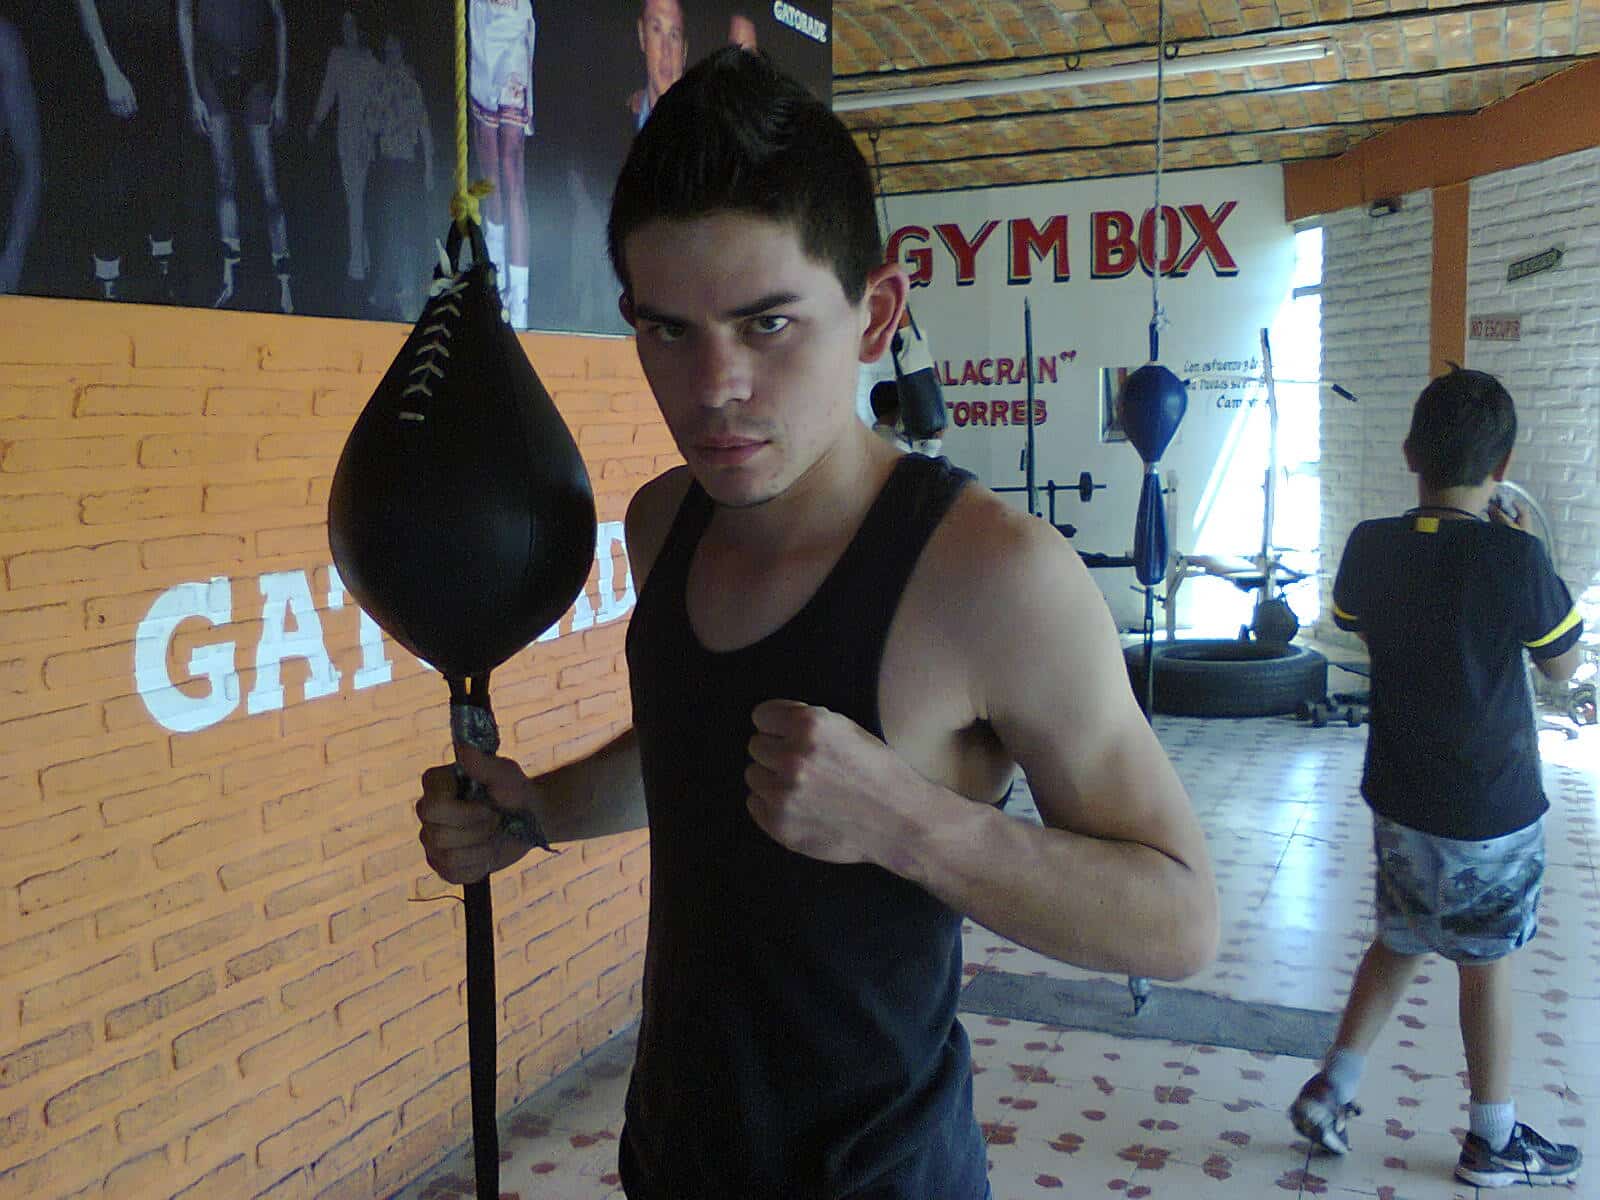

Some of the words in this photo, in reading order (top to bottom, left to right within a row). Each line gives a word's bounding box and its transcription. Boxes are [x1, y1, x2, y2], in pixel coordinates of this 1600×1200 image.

[773, 0, 828, 44] GATORADE
[884, 214, 1071, 290] GYM
[1090, 200, 1240, 281] BOX
